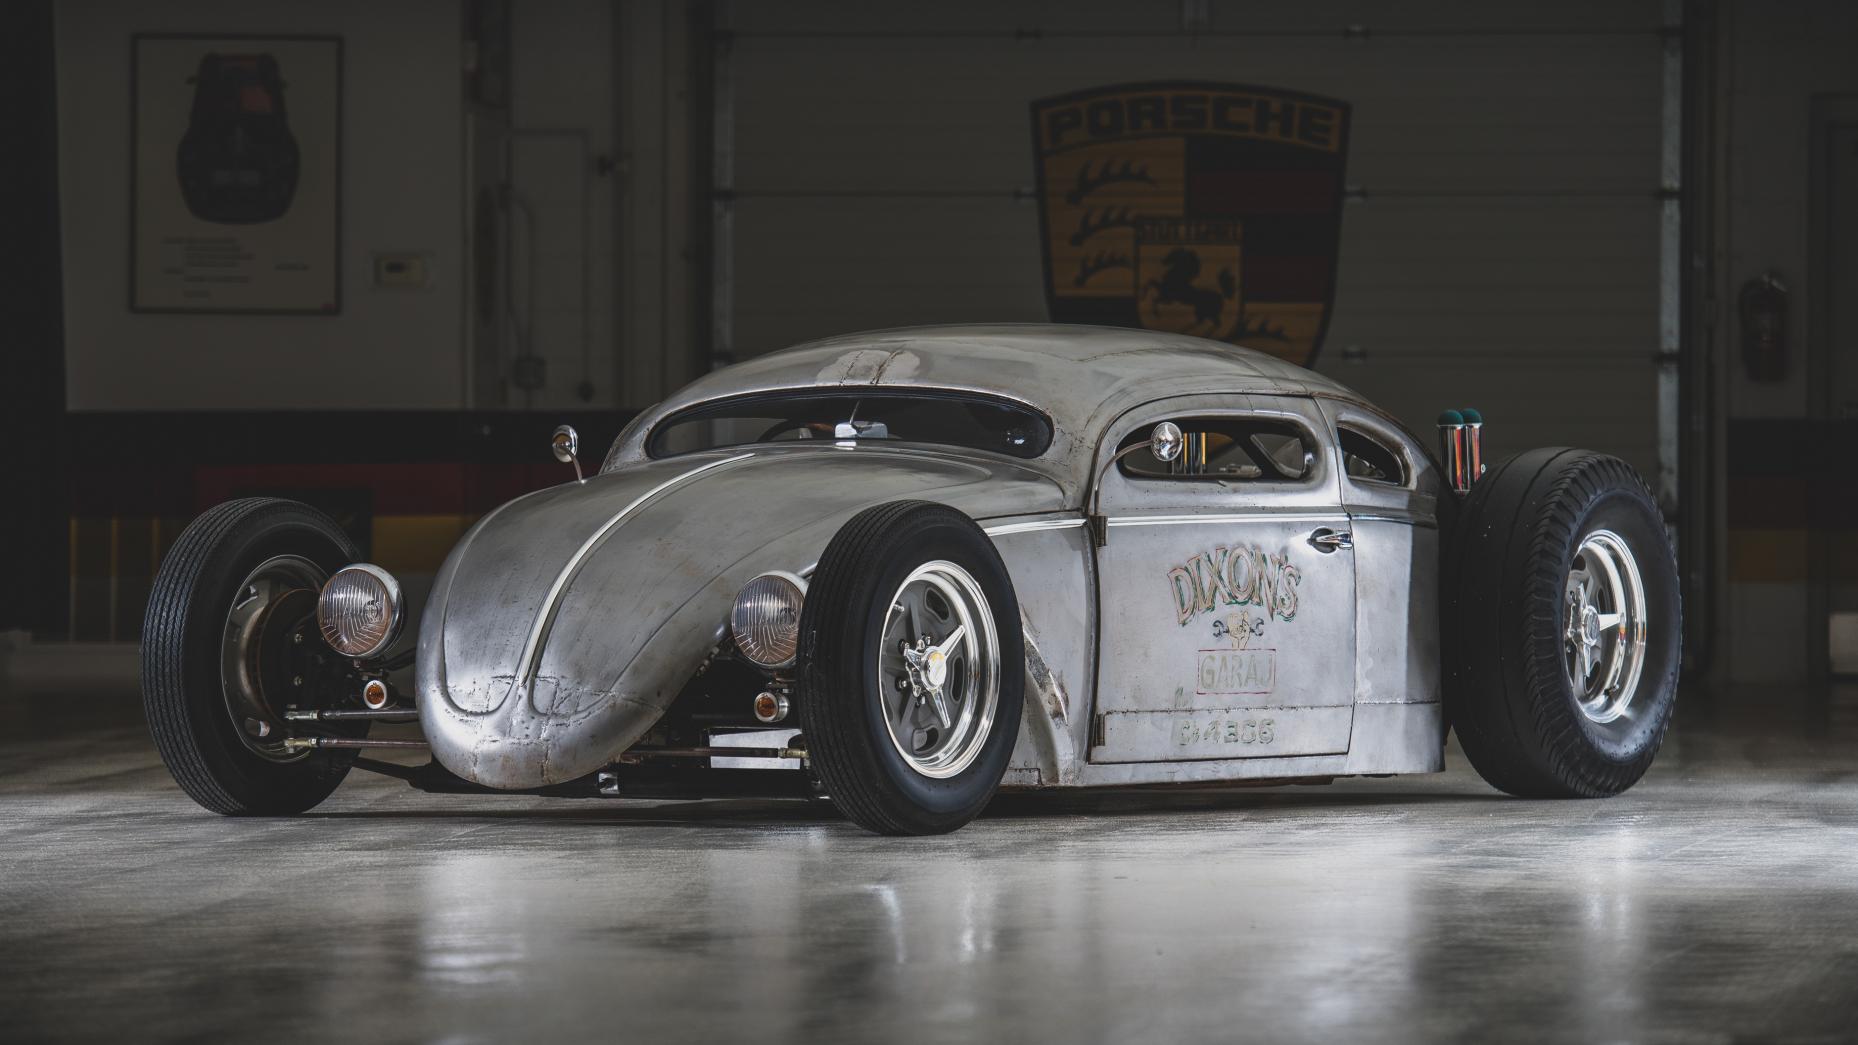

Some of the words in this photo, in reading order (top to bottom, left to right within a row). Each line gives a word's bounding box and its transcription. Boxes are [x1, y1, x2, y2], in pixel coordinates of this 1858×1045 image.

[1047, 94, 1333, 146] PORSCHE
[1167, 546, 1301, 627] DIXON'S
[1201, 654, 1274, 690] GARAJ
